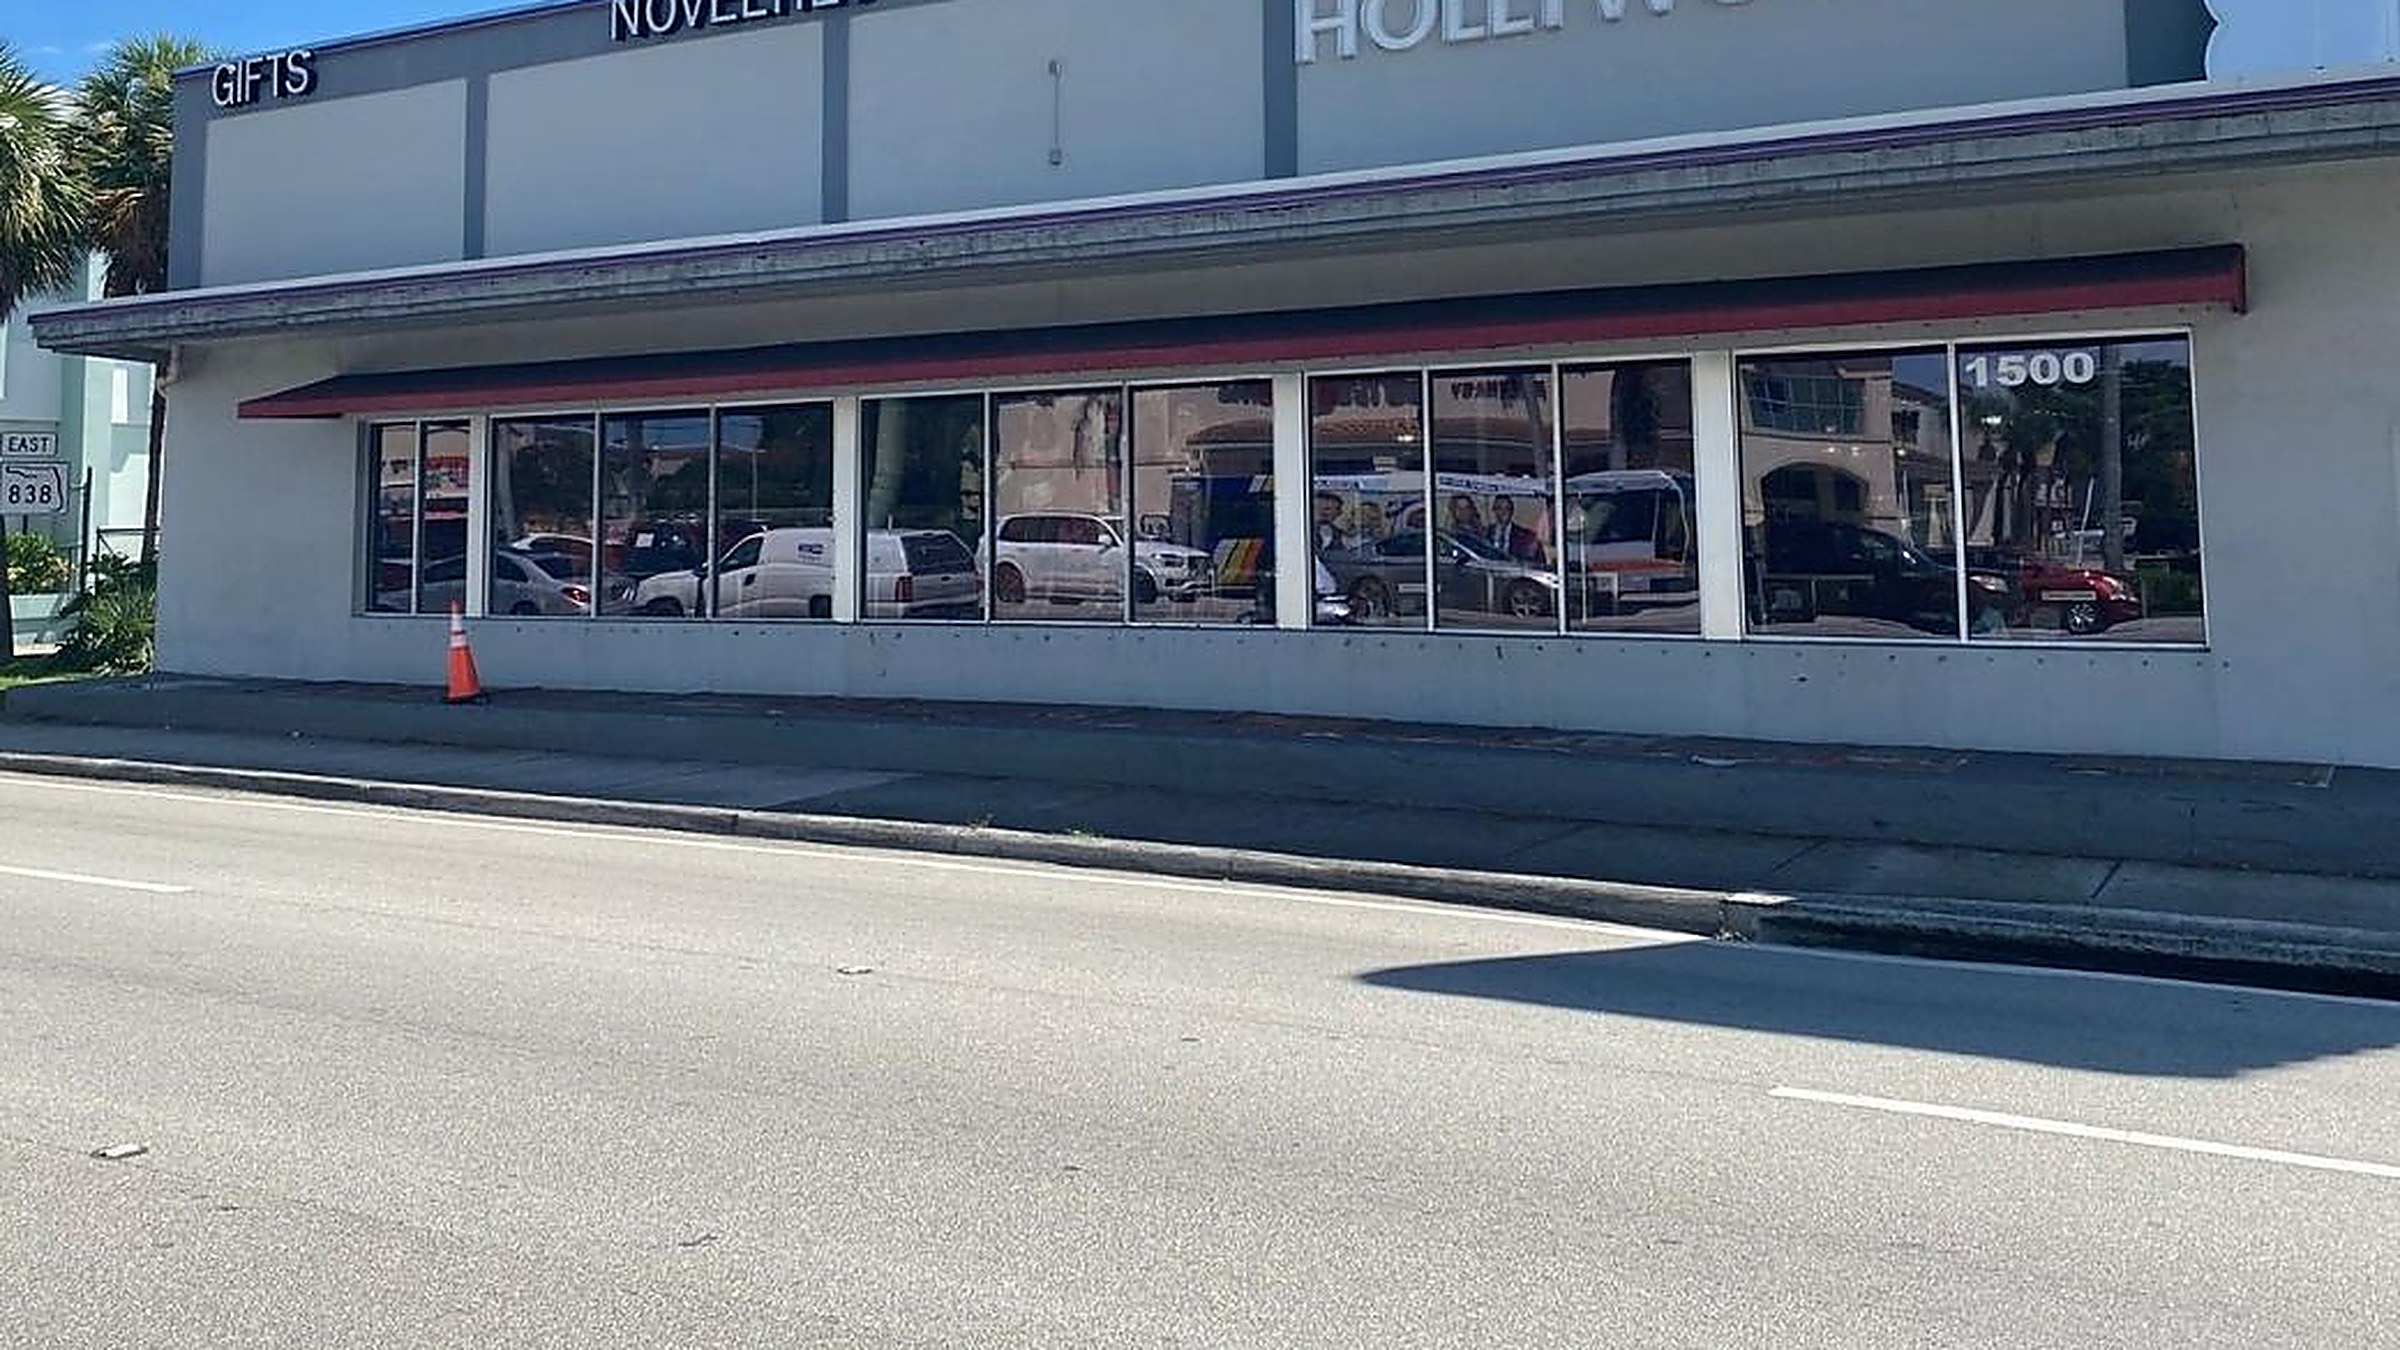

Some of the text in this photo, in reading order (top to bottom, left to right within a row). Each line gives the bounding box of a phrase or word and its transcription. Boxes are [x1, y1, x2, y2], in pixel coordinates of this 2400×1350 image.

[211, 50, 312, 105] GIFTS
[1965, 352, 2094, 387] 1500
[8, 436, 49, 452] EAST
[8, 484, 52, 504] 838
